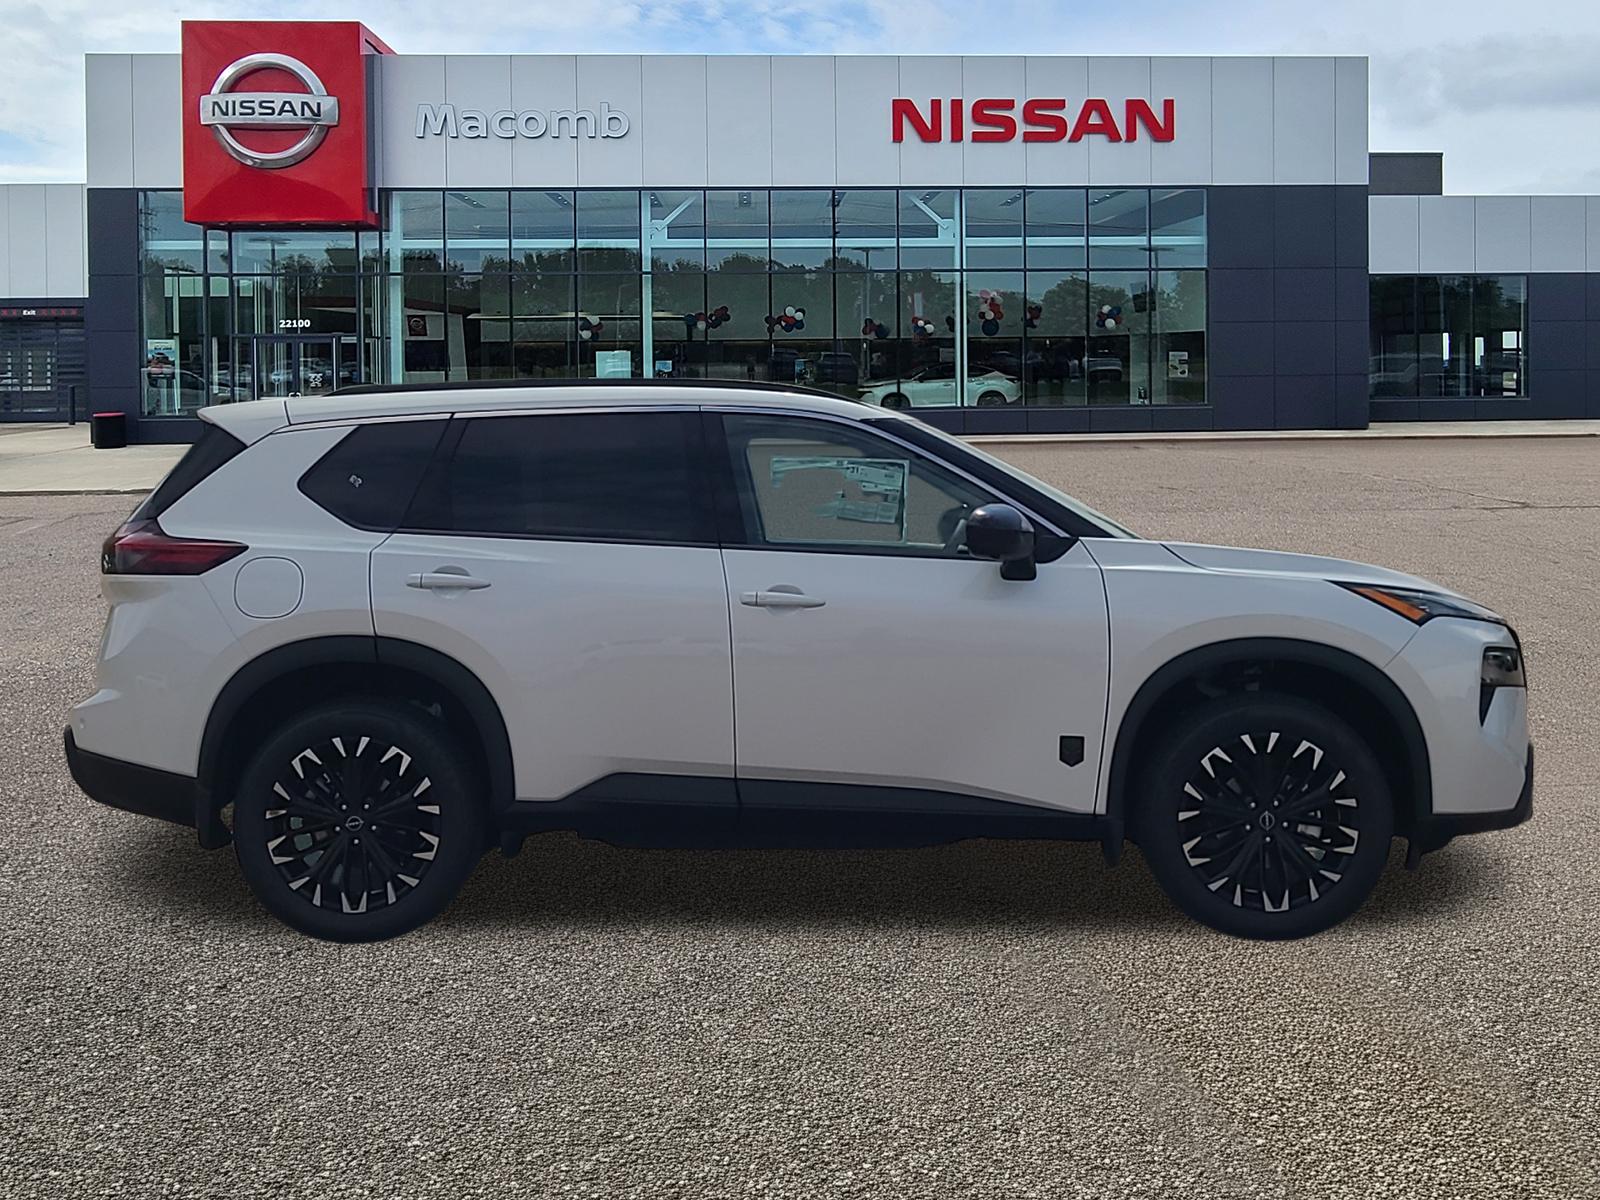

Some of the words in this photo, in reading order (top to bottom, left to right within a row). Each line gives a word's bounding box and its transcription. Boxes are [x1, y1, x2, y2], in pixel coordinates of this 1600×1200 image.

[211, 100, 322, 117] NISSAN
[415, 101, 630, 139] Macomb
[892, 98, 1176, 143] NISSAN
[279, 319, 311, 328] 22100
